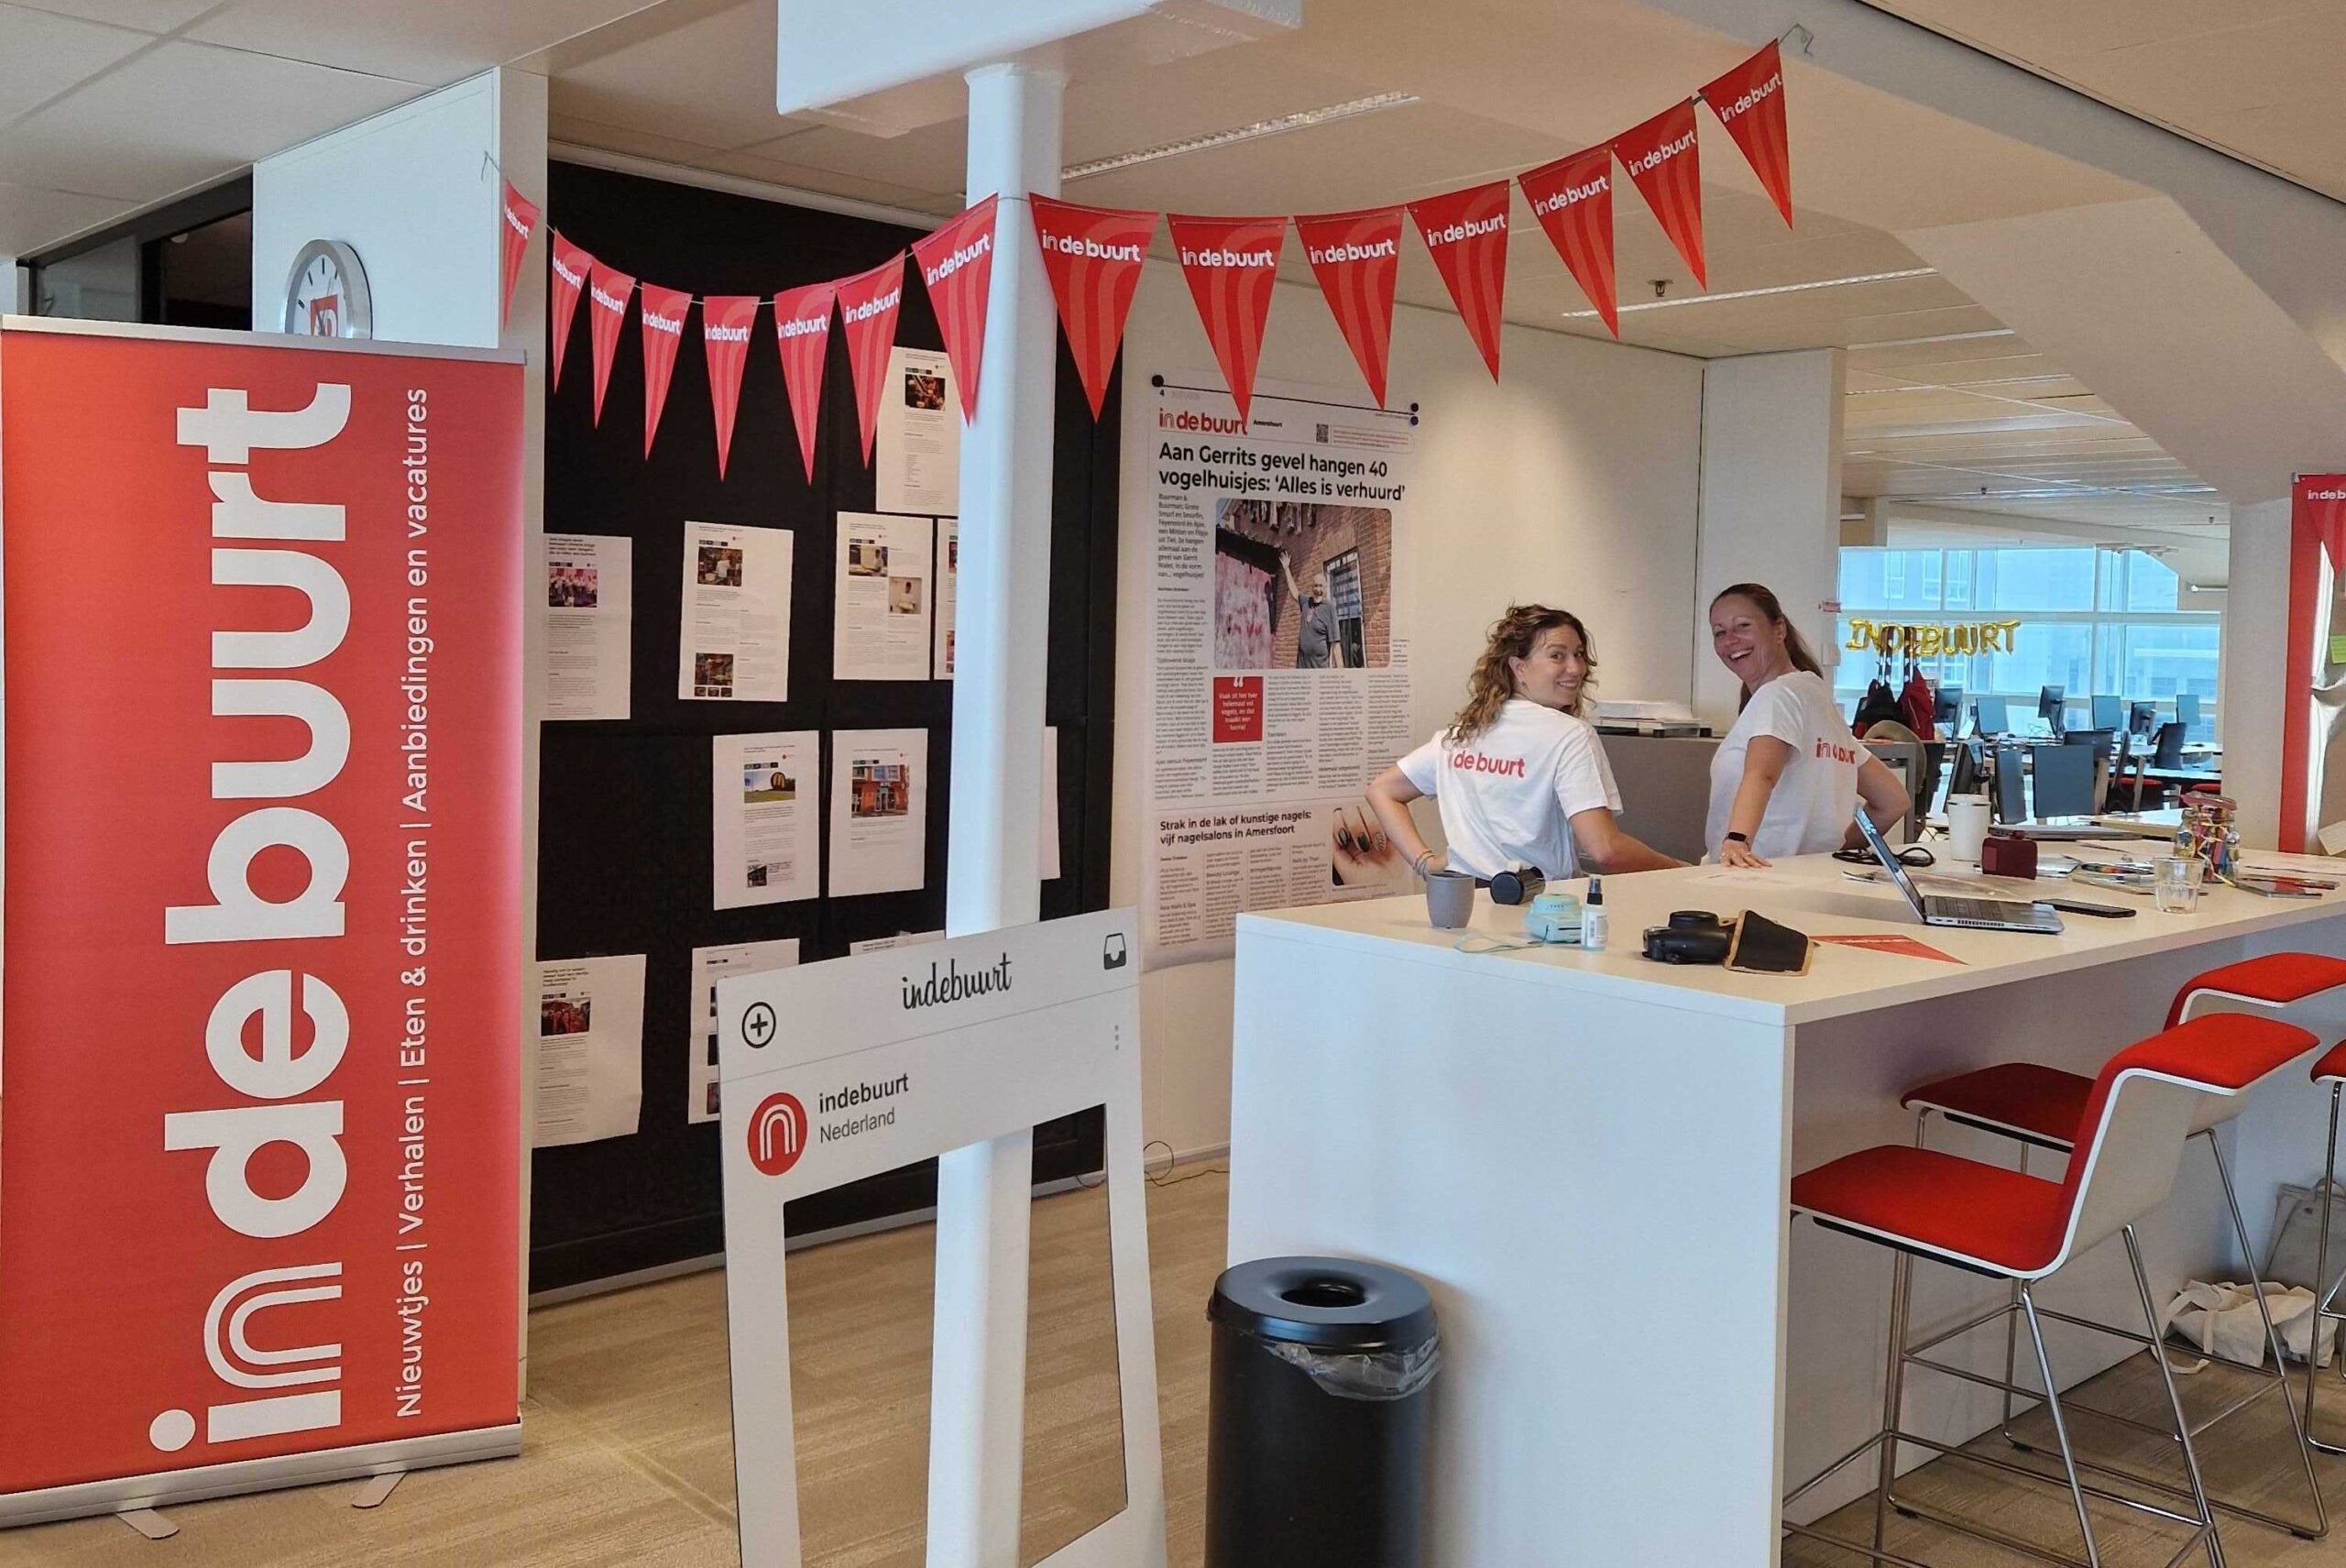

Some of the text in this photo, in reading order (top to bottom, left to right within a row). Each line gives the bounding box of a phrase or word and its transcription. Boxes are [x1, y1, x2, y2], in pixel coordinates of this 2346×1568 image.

[402, 388, 428, 538] vacatures
[1159, 442, 1387, 477] Aan Gerrits gevel hangen 40
[1159, 469, 1270, 494] vogelhuisjes:
[1321, 477, 1332, 495] is
[408, 549, 428, 587] en
[400, 598, 433, 812] Aanbiedingen
[1160, 810, 1312, 831] Strak in de lak of kunstige nagels:
[1160, 825, 1295, 847] vijf nagelsalons in Amersfoort
[400, 839, 428, 956] drinken
[400, 966, 427, 987] &
[902, 951, 1013, 1010] indebuurt
[400, 996, 427, 1069] Eten
[818, 1072, 909, 1113] indebuurt
[820, 1107, 895, 1144] Nederland
[398, 1095, 426, 1235] Verhalen
[396, 1261, 430, 1418] Nieuwtjes
